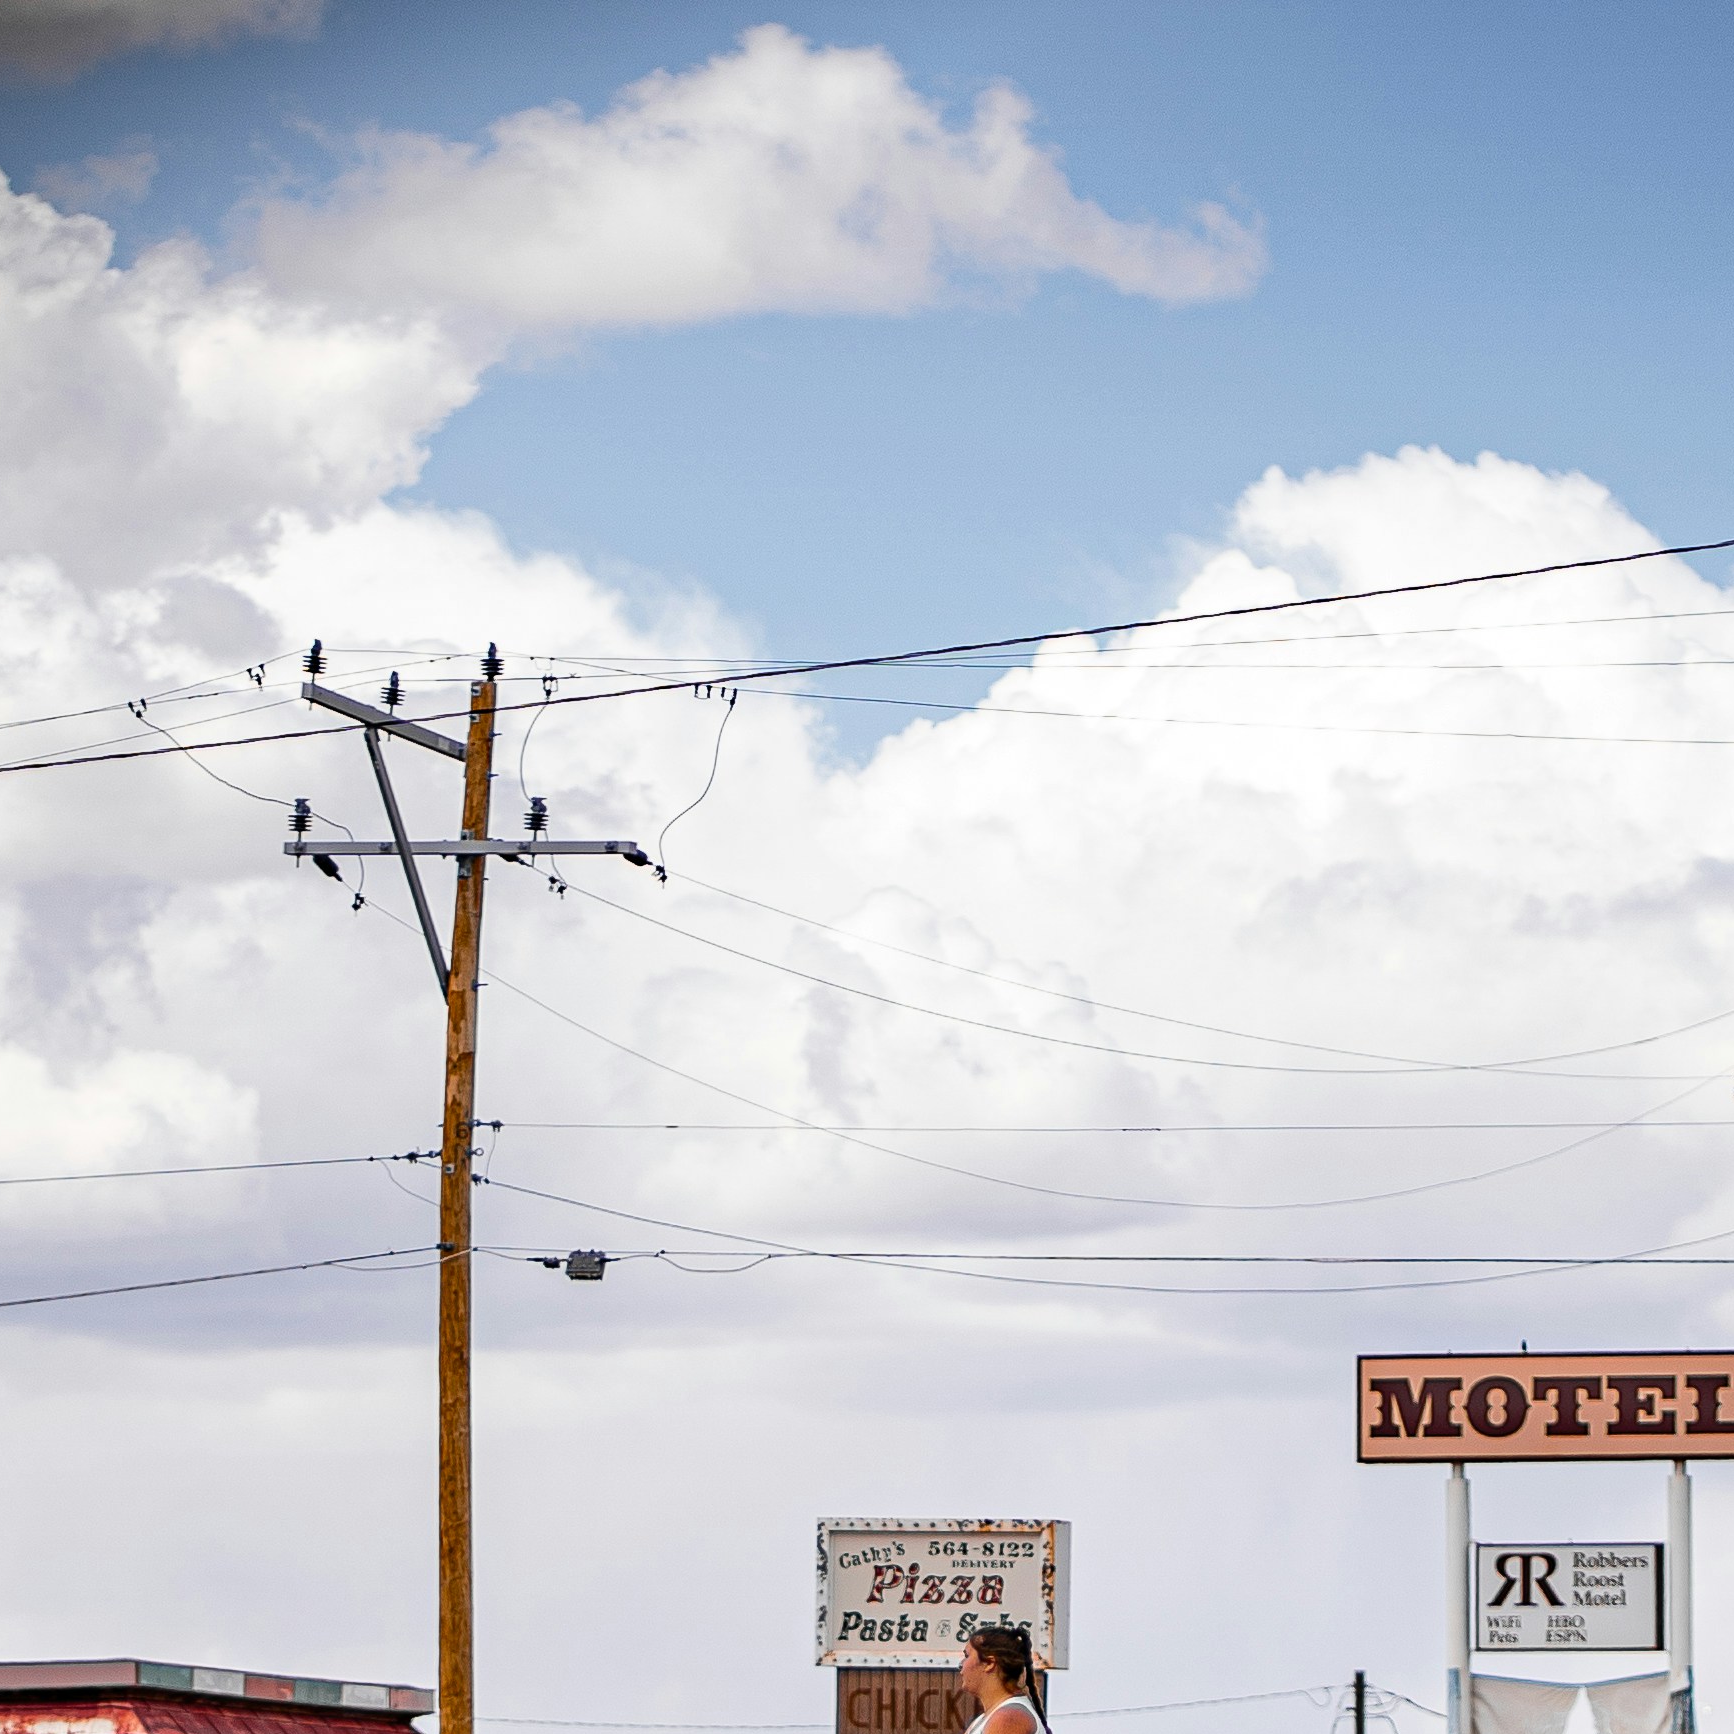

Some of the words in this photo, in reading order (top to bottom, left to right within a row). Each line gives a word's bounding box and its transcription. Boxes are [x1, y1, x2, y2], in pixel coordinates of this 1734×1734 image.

[839, 1541, 906, 1569] Cathy's
[927, 1541, 1035, 1558] 564-8122
[1573, 1551, 1649, 1568] Robbers
[951, 1560, 1016, 1569] DELIVERY
[866, 1562, 1005, 1605] Pizza
[1573, 1570, 1625, 1587] Roost
[1572, 1589, 1627, 1606] Motel
[837, 1610, 929, 1643] Pasta
